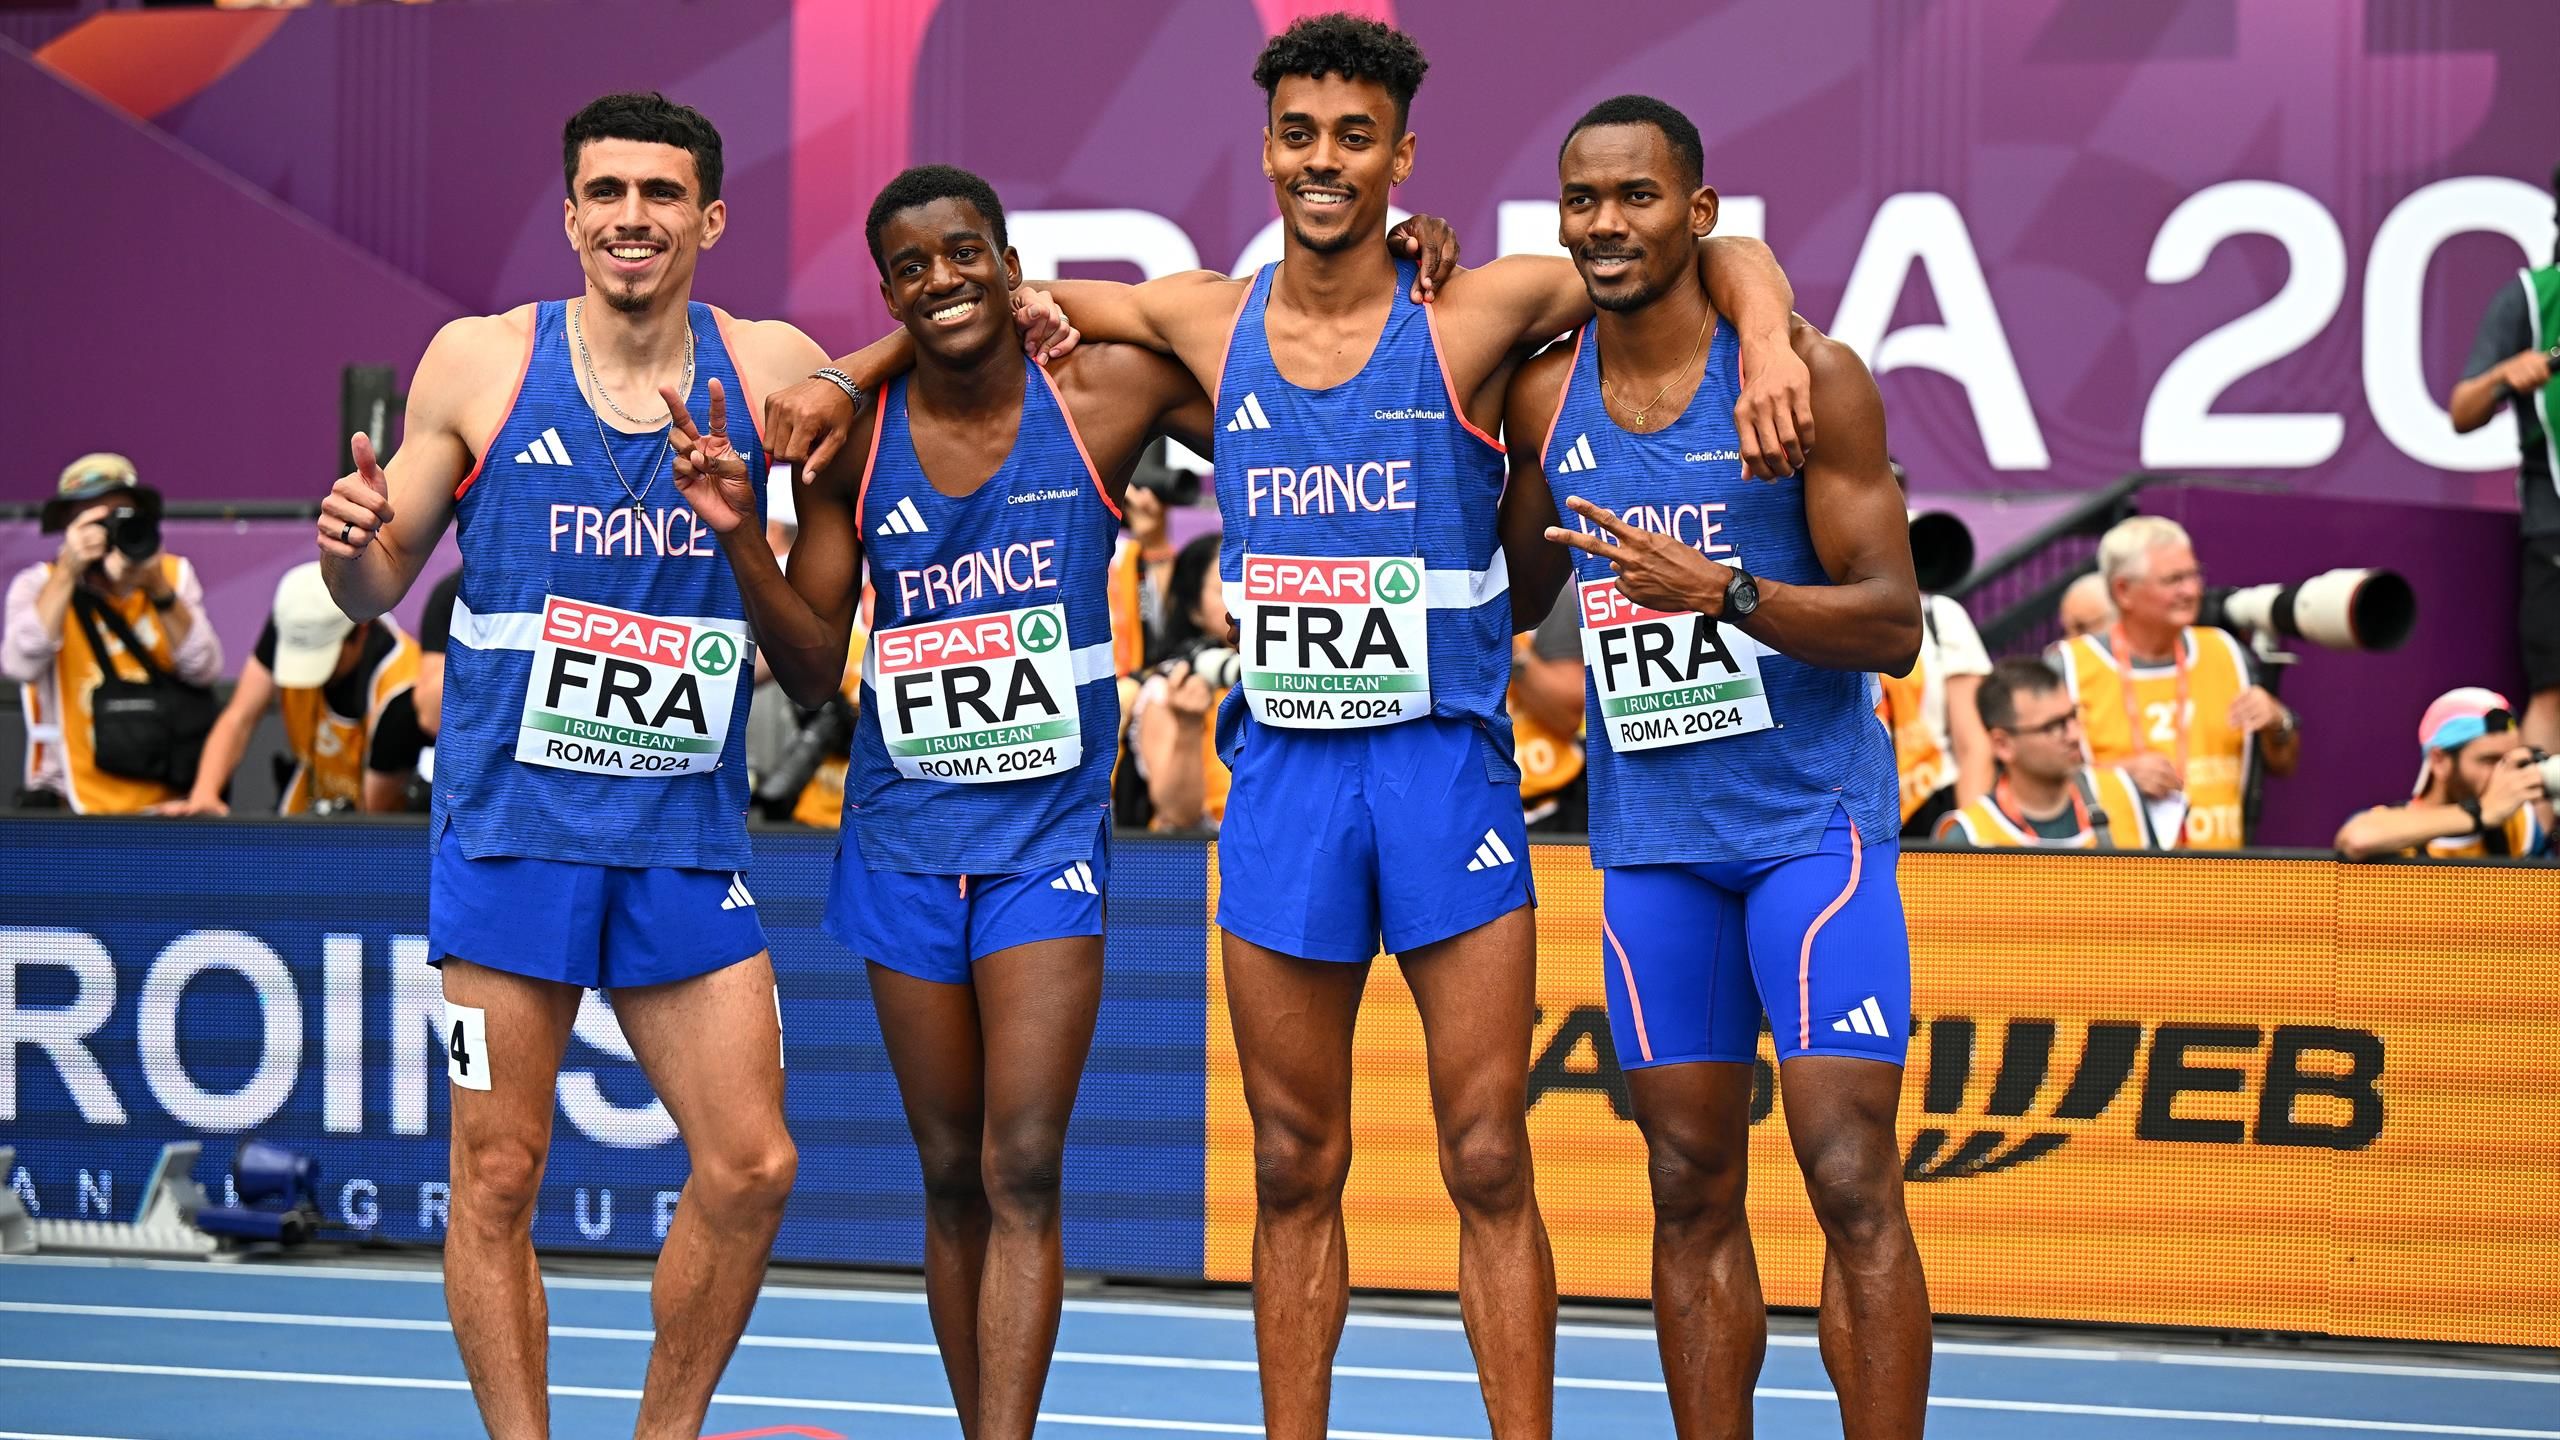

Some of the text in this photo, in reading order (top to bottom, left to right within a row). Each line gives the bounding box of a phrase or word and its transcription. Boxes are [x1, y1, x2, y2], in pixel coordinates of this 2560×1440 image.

[1374, 409, 1446, 420] Crédit Mutuel
[1685, 451, 1713, 463] Crédit
[1007, 487, 1079, 505] Crédit Mutuel
[1247, 460, 1416, 517] FRANCE
[550, 503, 715, 557] FRANCE
[897, 538, 1057, 617] FRANCE
[1248, 564, 1367, 598] SPAR
[548, 605, 686, 662] SPAR
[882, 620, 1011, 668] SPAR
[1255, 605, 1410, 669] FRA
[1598, 614, 1742, 693] FRA
[545, 647, 709, 736] FRA
[894, 657, 1061, 735] FRA
[1274, 674, 1280, 690] I
[1282, 675, 1317, 691] RUN
[1265, 697, 1403, 720] ROMA 2024
[1623, 699, 1630, 713] I
[1630, 694, 1660, 713] RUN
[564, 719, 570, 733] I
[573, 721, 613, 741] RUN
[1620, 706, 1743, 743] ROMA 2024
[546, 738, 690, 771] ROMA 2024
[925, 739, 931, 753] I
[934, 734, 972, 752] RUN
[918, 746, 1057, 777] ROMA 2024
[450, 1019, 470, 1077] 4
